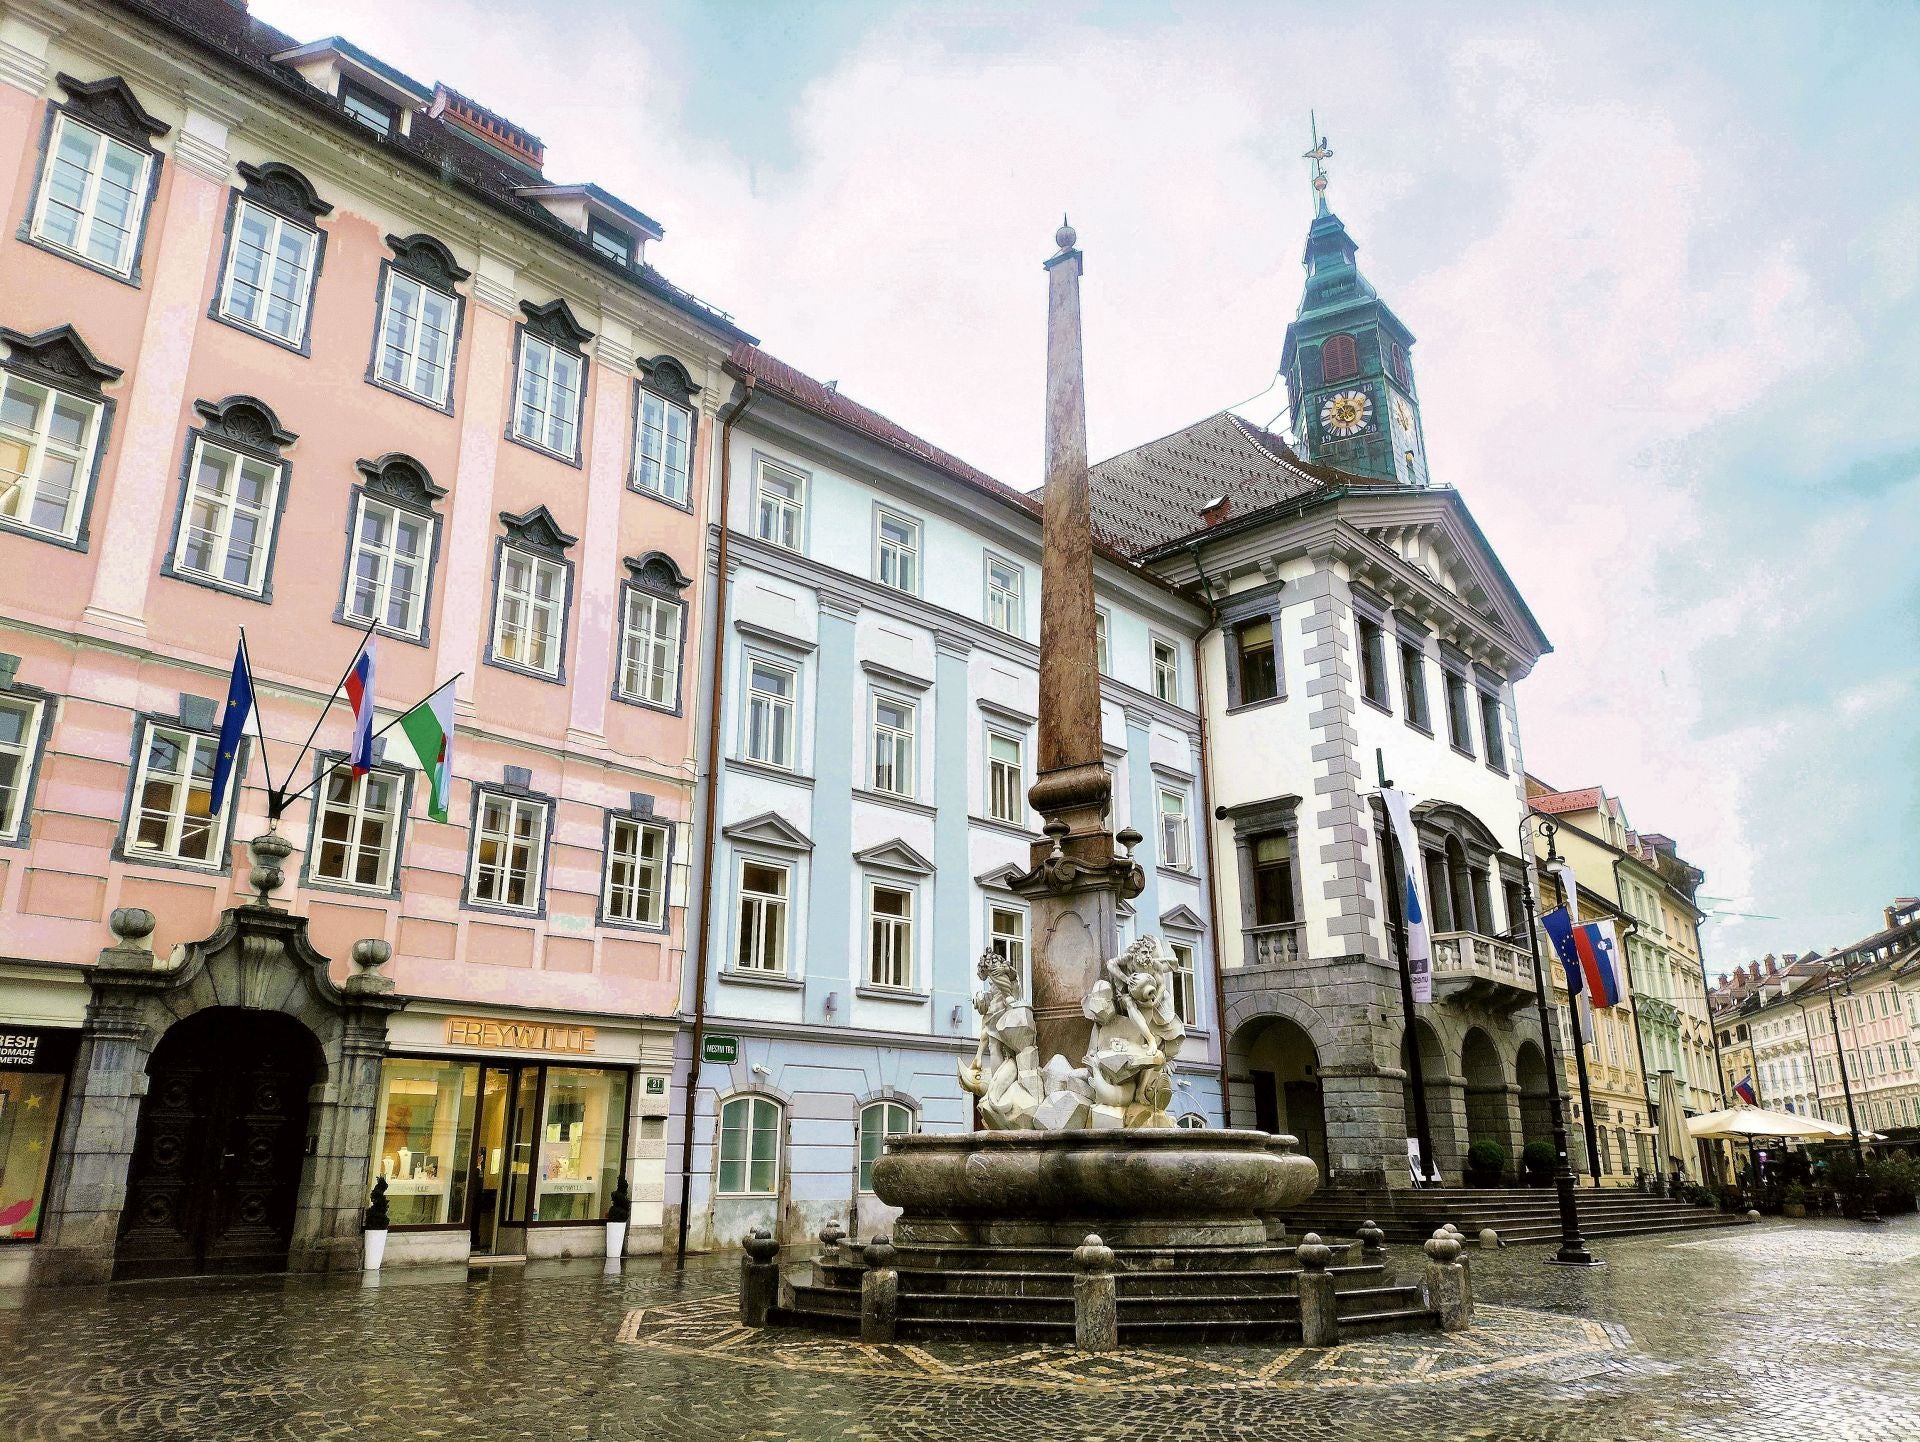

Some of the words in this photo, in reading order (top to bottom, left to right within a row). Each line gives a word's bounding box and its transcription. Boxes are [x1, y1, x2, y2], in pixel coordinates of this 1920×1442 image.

[1321, 435, 1332, 443] 19
[447, 1020, 596, 1052] FREYWILLE
[0, 1048, 36, 1057] DMADE
[706, 1044, 725, 1054] MESTNI
[725, 1045, 735, 1055] TRG
[652, 1079, 660, 1088] 21
